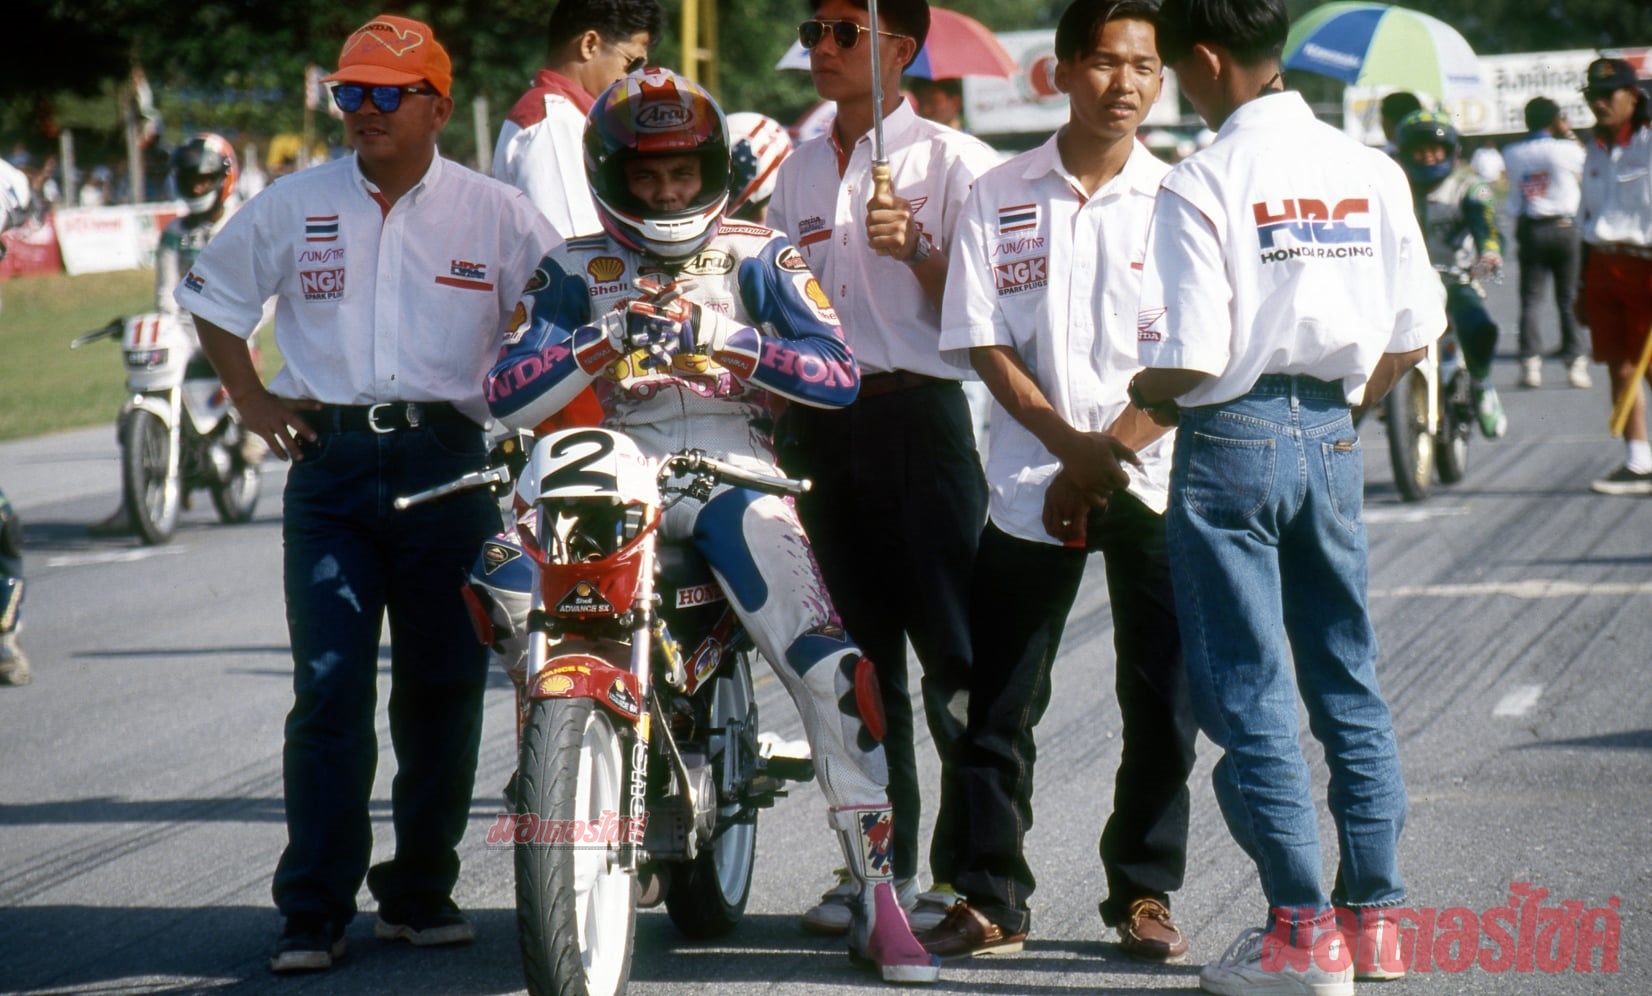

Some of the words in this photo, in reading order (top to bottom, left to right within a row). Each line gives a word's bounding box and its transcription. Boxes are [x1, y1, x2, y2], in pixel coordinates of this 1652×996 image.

[1252, 198, 1371, 249] HRC
[992, 237, 1045, 257] SUNSTAR
[1317, 246, 1374, 258] RACING
[301, 269, 344, 293] NGK
[994, 257, 1046, 289] NGK
[1024, 279, 1048, 291] PLUGS
[589, 283, 628, 296] Shell
[487, 344, 571, 403] NDA
[761, 342, 856, 388] HON
[541, 430, 618, 494] 2
[559, 604, 597, 613] ADVANCE
